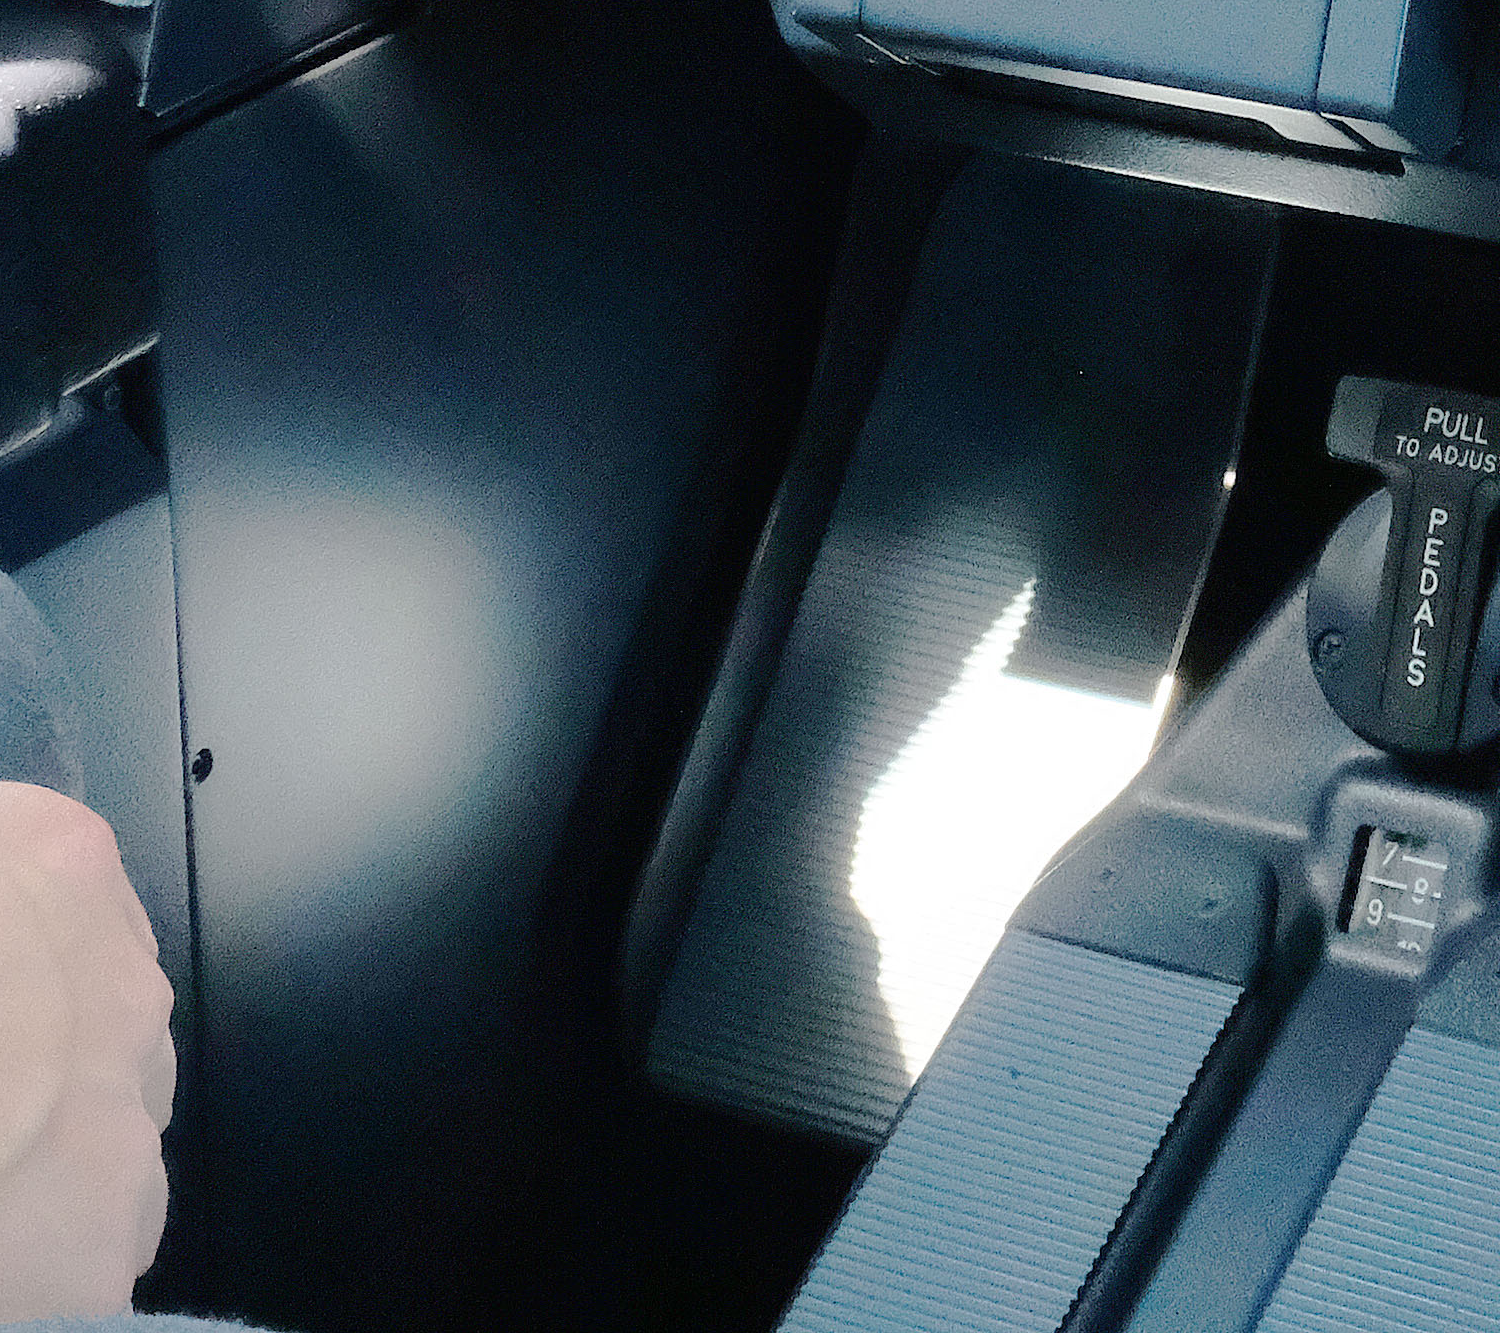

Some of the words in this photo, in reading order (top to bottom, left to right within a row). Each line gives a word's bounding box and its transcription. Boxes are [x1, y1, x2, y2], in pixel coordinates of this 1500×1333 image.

[1396, 436, 1420, 456] TO
[1424, 407, 1488, 446] PULL
[1406, 508, 1448, 686] PEDALS
